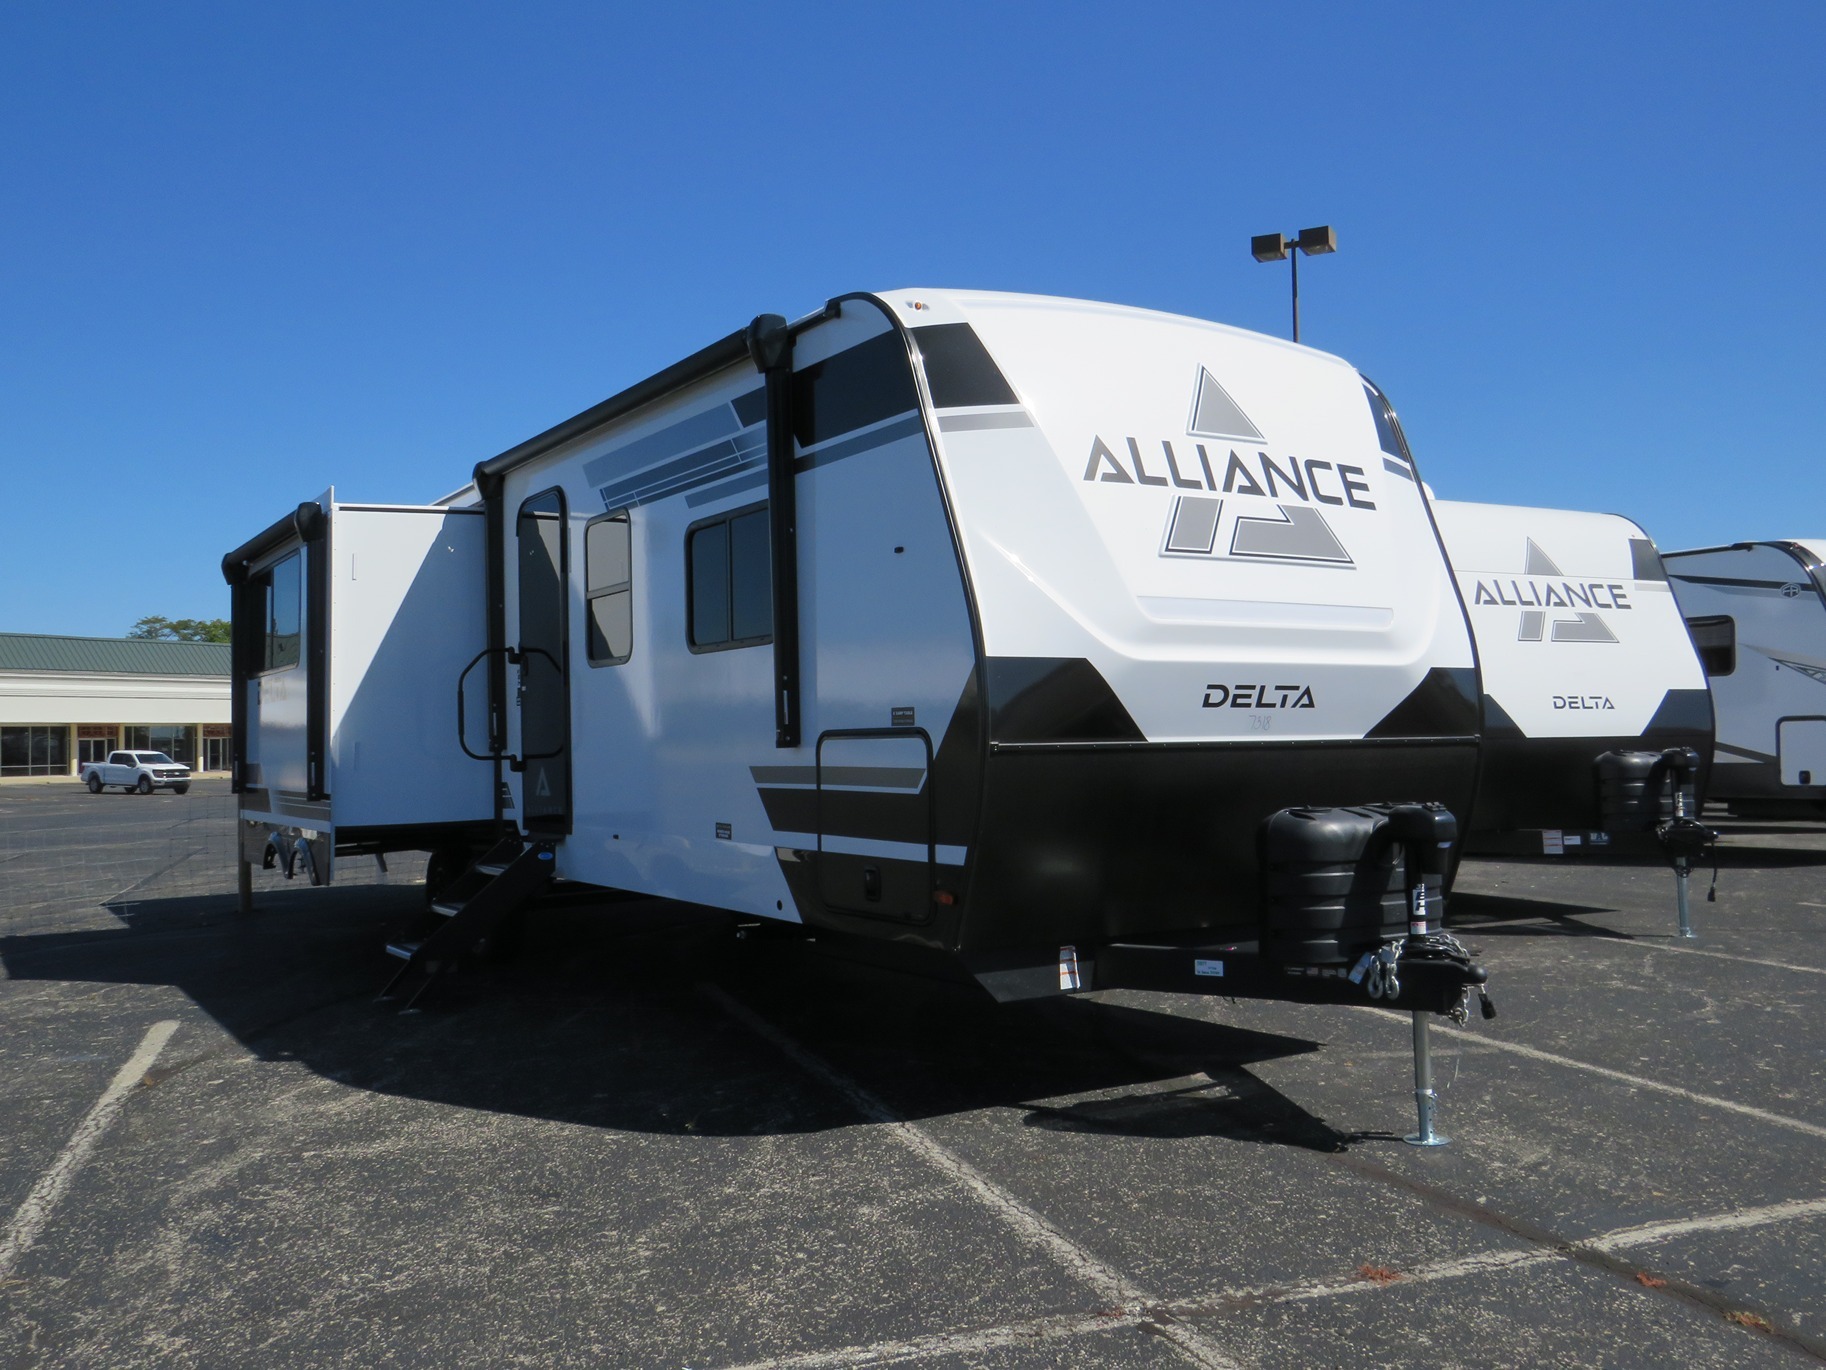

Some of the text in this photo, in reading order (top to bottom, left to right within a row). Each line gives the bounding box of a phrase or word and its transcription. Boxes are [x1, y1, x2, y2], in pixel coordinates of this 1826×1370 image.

[1083, 435, 1376, 510] ALLIANCE
[1475, 580, 1631, 609] ALLIANCE
[1202, 684, 1315, 708] DELTA
[1552, 696, 1615, 709] DELTA
